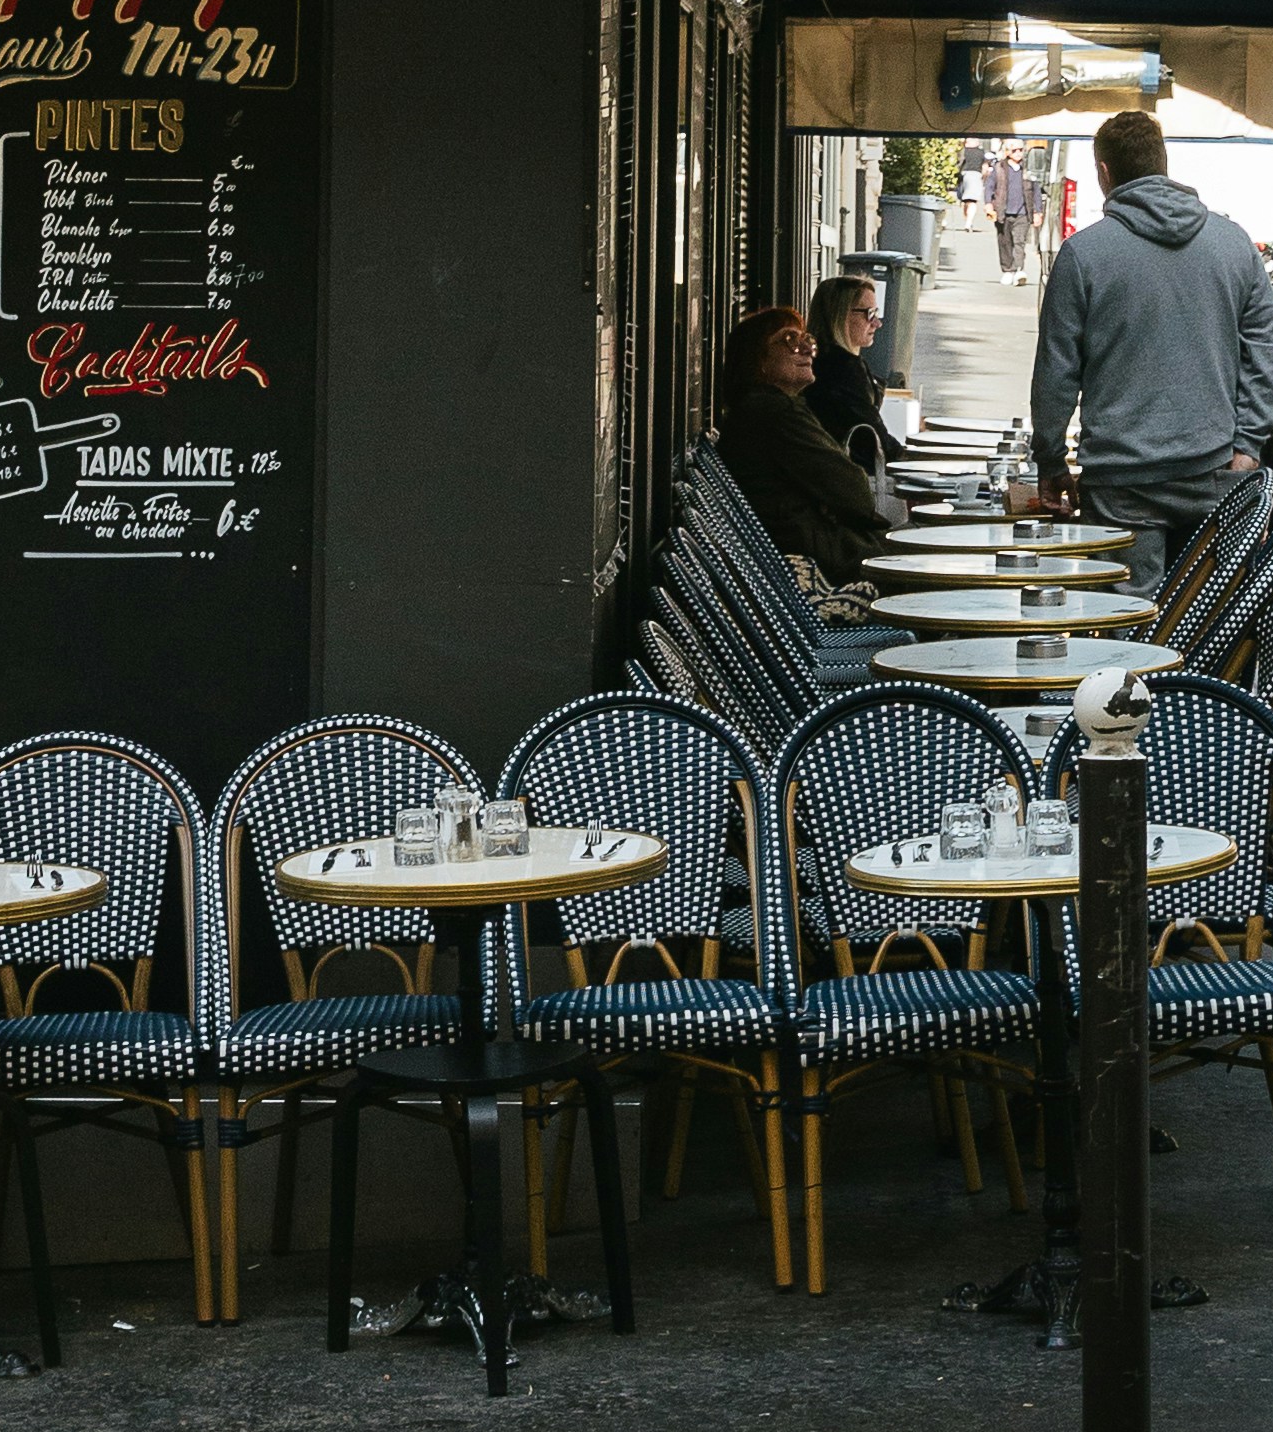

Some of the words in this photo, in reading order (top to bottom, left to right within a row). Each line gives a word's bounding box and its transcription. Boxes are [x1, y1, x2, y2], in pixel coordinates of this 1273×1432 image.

[34, 98, 186, 153] PINTES
[43, 158, 108, 186] Pilsner
[42, 189, 77, 211] 1664
[40, 212, 101, 239] Blanche
[207, 217, 236, 237] 6.50
[41, 240, 112, 268] Brooklyn
[207, 244, 233, 265] 7.50
[207, 291, 232, 310] 7.50
[28, 318, 270, 399] Cocktails
[75, 445, 151, 477] TAPAS
[44, 490, 132, 525] Assiette
[142, 492, 192, 522] Frites
